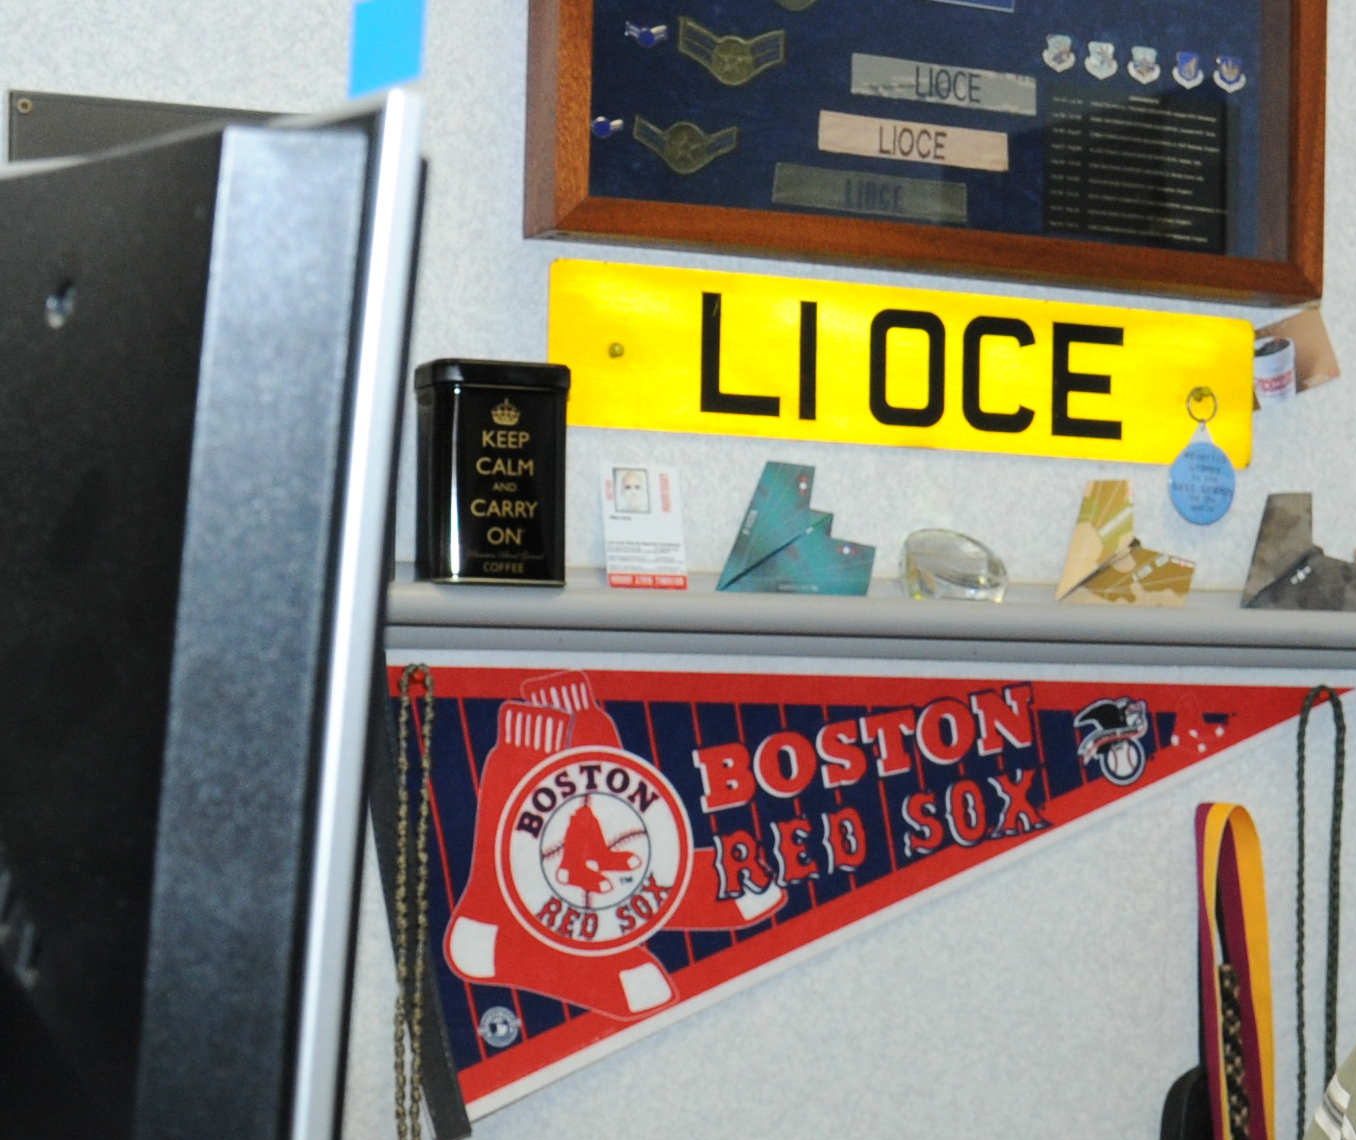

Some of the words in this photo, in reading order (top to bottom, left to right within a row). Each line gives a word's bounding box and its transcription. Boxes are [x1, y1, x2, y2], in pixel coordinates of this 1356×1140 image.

[915, 66, 981, 103] LIOCE
[878, 125, 948, 160] LIOCE
[482, 430, 530, 449] KEEP
[475, 457, 534, 476] CALM
[492, 482, 518, 493] AND
[470, 498, 538, 519] CARRY
[487, 526, 523, 545] ON
[482, 561, 525, 574] COFFEE
[692, 681, 1034, 814] BOSTON
[515, 764, 660, 840] BOSTON
[714, 807, 869, 900] RED
[902, 767, 1048, 858] SOX
[535, 896, 600, 942] RED
[616, 871, 673, 936] SOX
